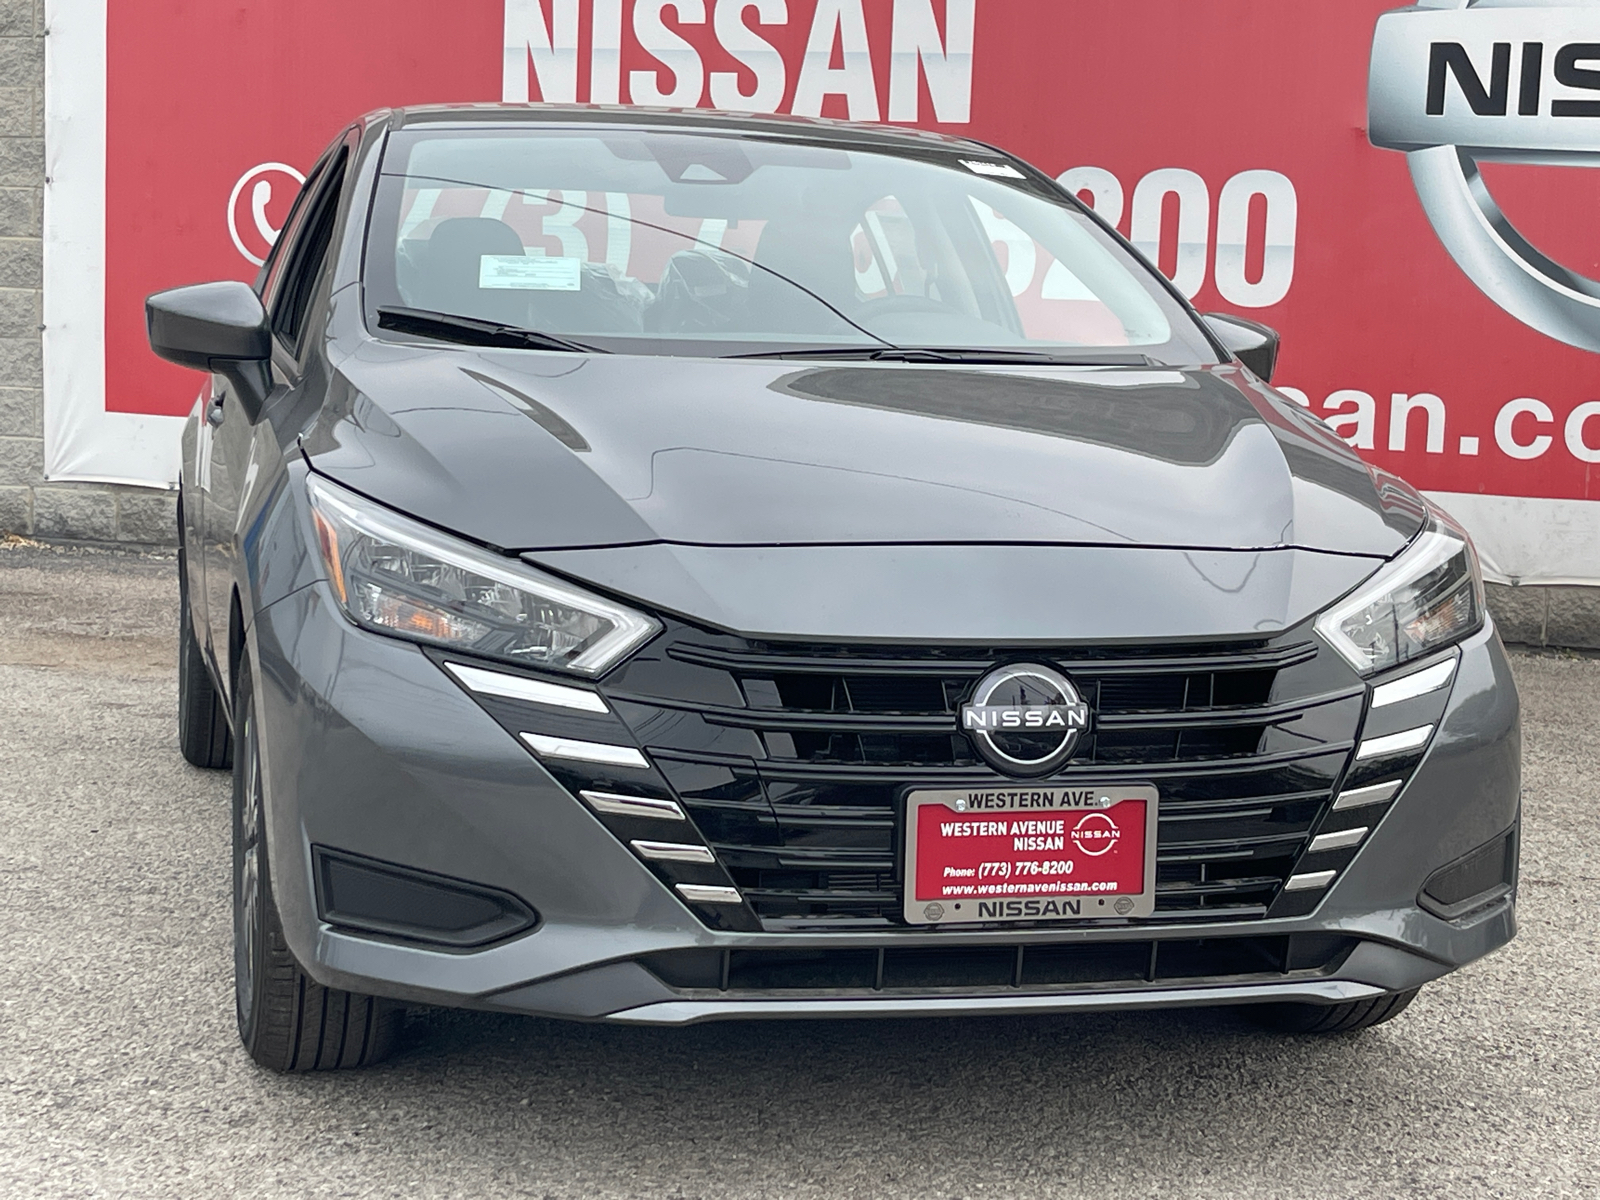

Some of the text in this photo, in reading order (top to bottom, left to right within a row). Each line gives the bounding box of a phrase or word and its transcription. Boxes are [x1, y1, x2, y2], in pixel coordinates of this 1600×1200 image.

[502, 0, 976, 123] NISSAN
[966, 709, 1086, 727] NISSAN
[968, 790, 1098, 809] WESTERN AVE.
[940, 820, 1065, 837] WESTERN AVENUE
[1071, 830, 1120, 839] NISSAN
[1013, 836, 1064, 852] NISSAN
[943, 860, 1074, 880] Phone: (773) 776-8200
[942, 880, 1118, 895] www.westernavenissan.com
[978, 899, 1081, 918] NISSAN
